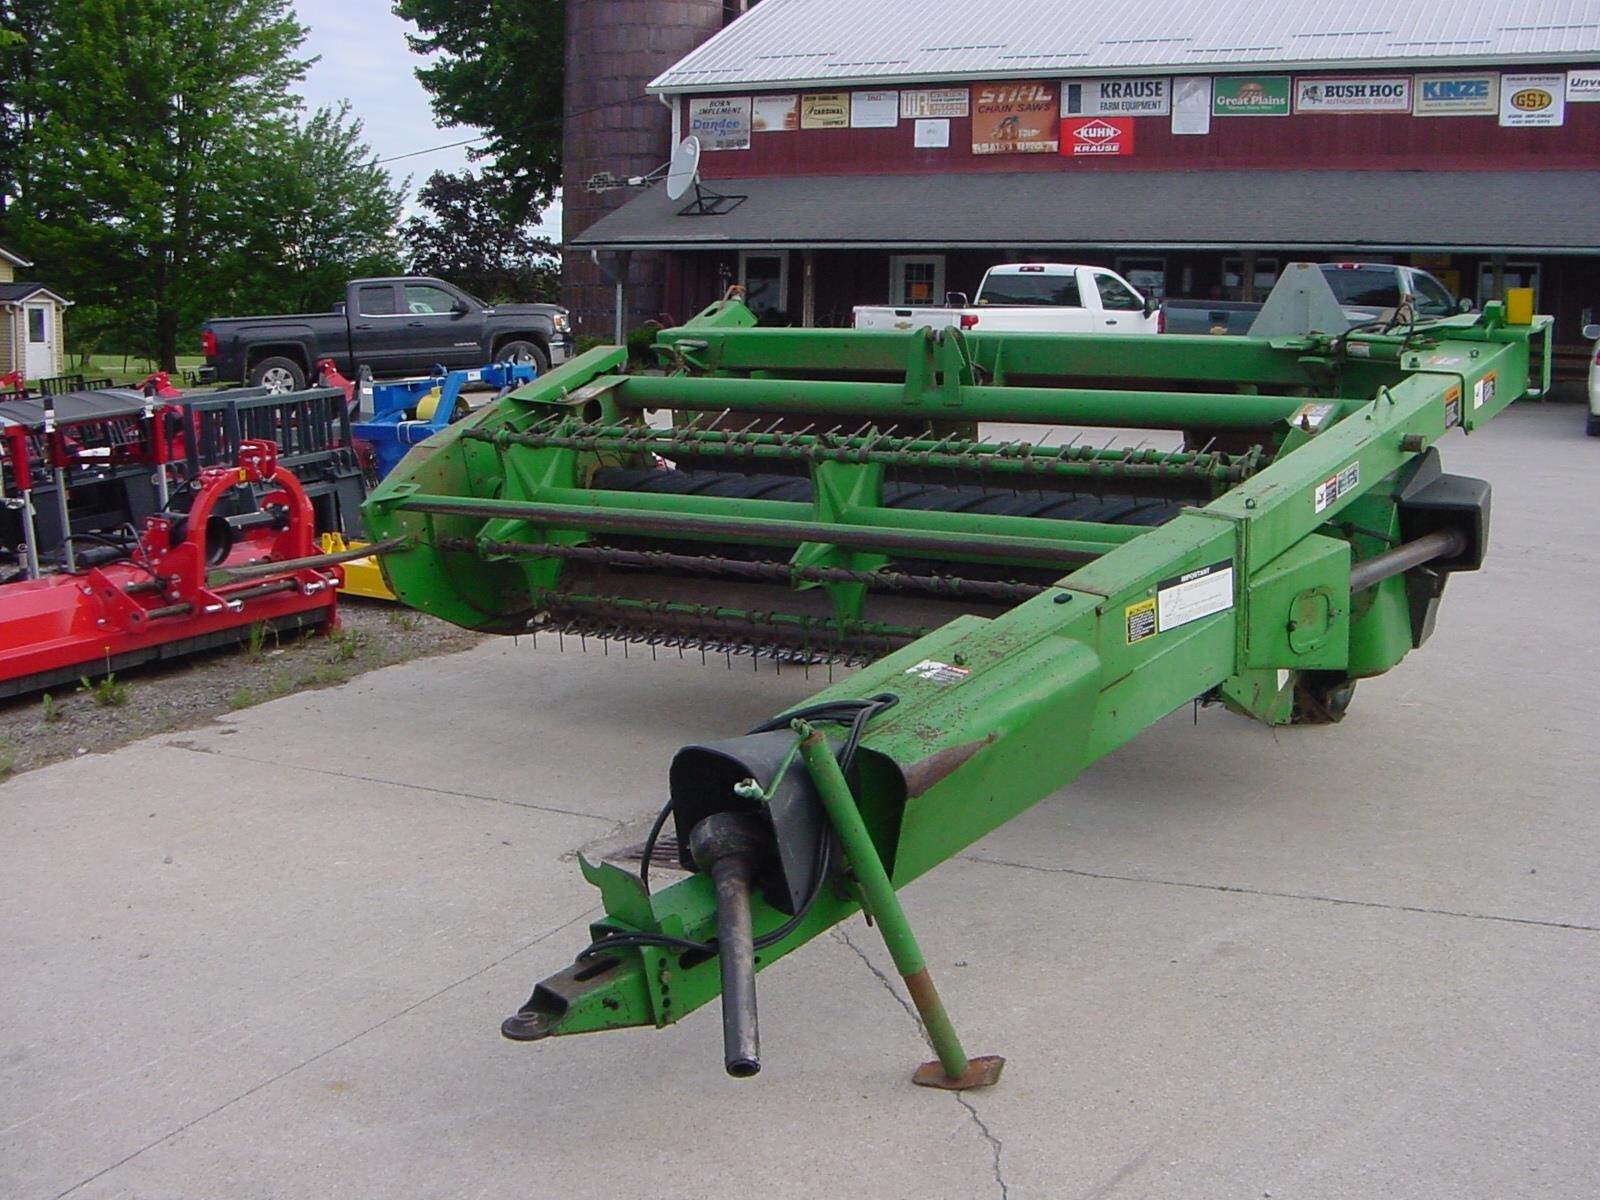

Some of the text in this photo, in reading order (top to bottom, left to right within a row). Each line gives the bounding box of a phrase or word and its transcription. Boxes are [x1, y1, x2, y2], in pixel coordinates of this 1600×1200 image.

[1571, 77, 1600, 87] Unv
[978, 85, 1053, 104] STIHL
[1100, 81, 1163, 98] KRAUSE
[1325, 84, 1404, 98] BUSH HOG
[1423, 81, 1489, 98] KINZE
[1217, 94, 1286, 106] Great Plains
[1516, 93, 1546, 108] GSI
[978, 103, 1013, 114] CHAIN
[1016, 102, 1052, 113] SAWS
[1100, 101, 1161, 112] FARM EQUIPMENT
[693, 119, 741, 131] Dundee
[1080, 127, 1114, 138] KUHN
[1073, 144, 1120, 153] KRAUSE
